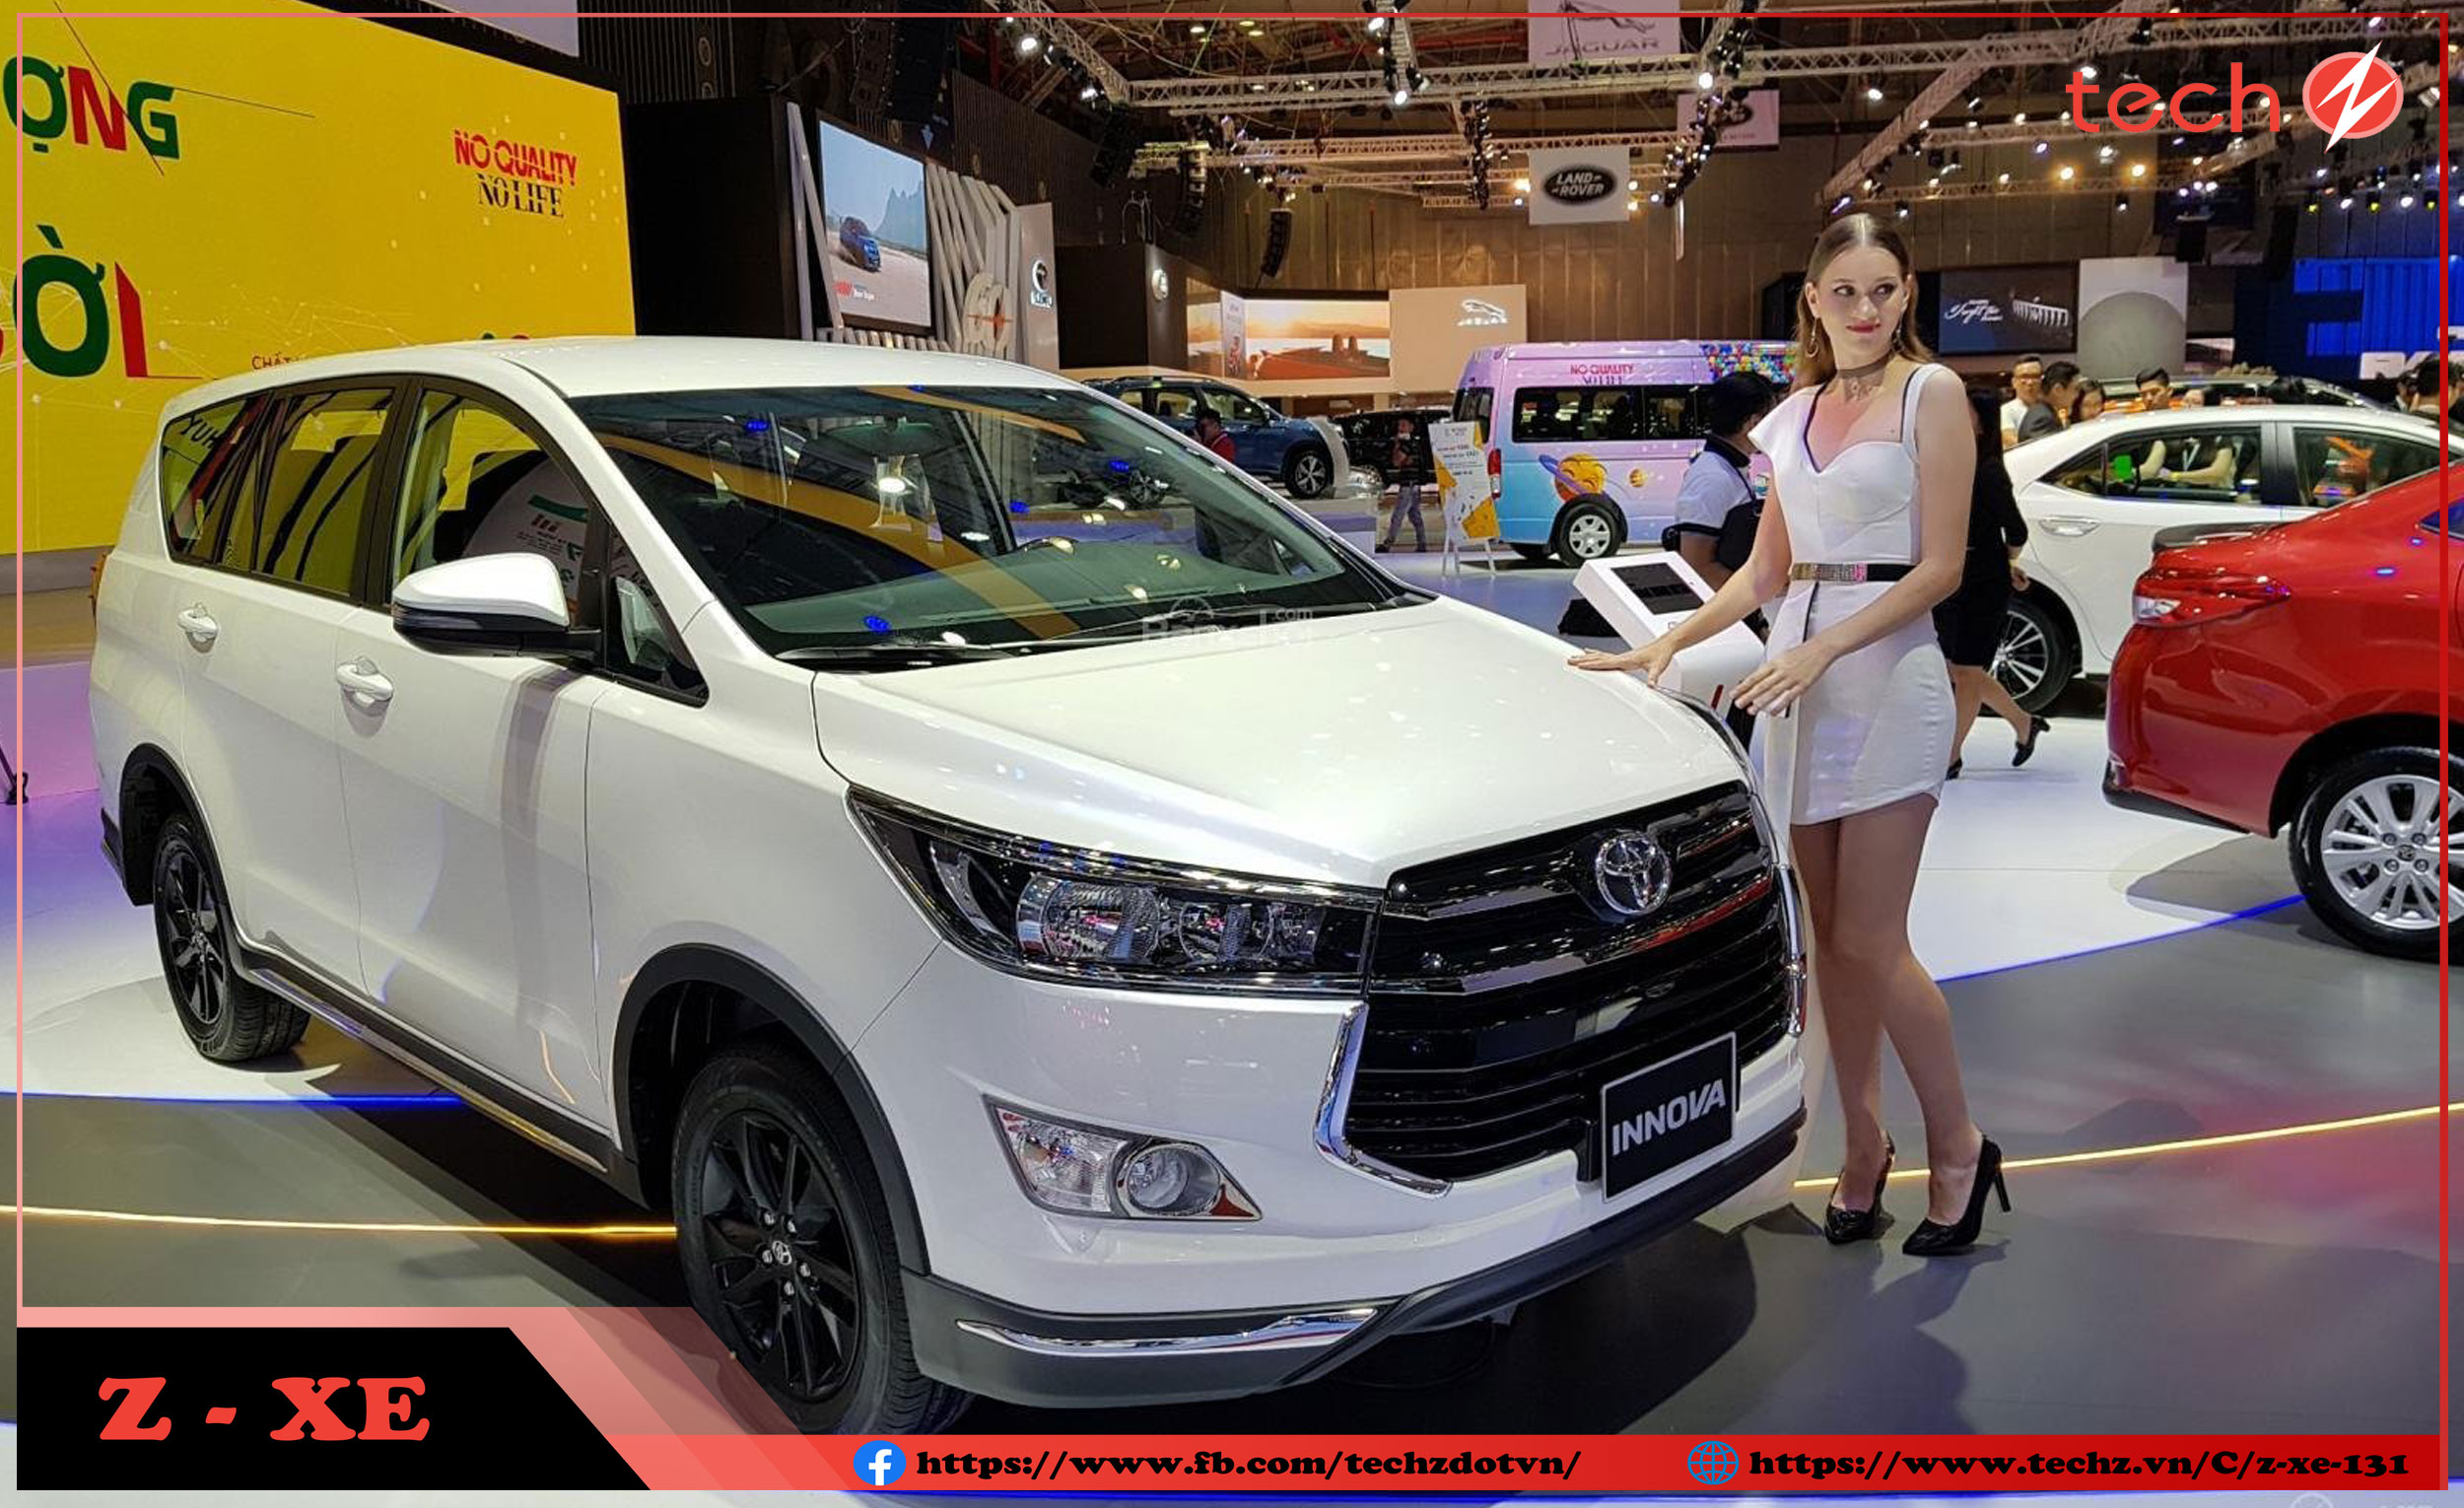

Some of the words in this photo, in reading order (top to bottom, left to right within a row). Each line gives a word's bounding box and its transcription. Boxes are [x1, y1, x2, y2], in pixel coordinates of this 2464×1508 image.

[454, 129, 491, 170] NO
[494, 140, 577, 186] QUALITY
[1556, 171, 1594, 185] LAND
[477, 172, 510, 208] NO
[513, 178, 564, 218] LIFE
[1559, 183, 1605, 197] ROVER
[0, 224, 148, 378] ỜI
[1612, 1078, 1726, 1156] INNOVA
